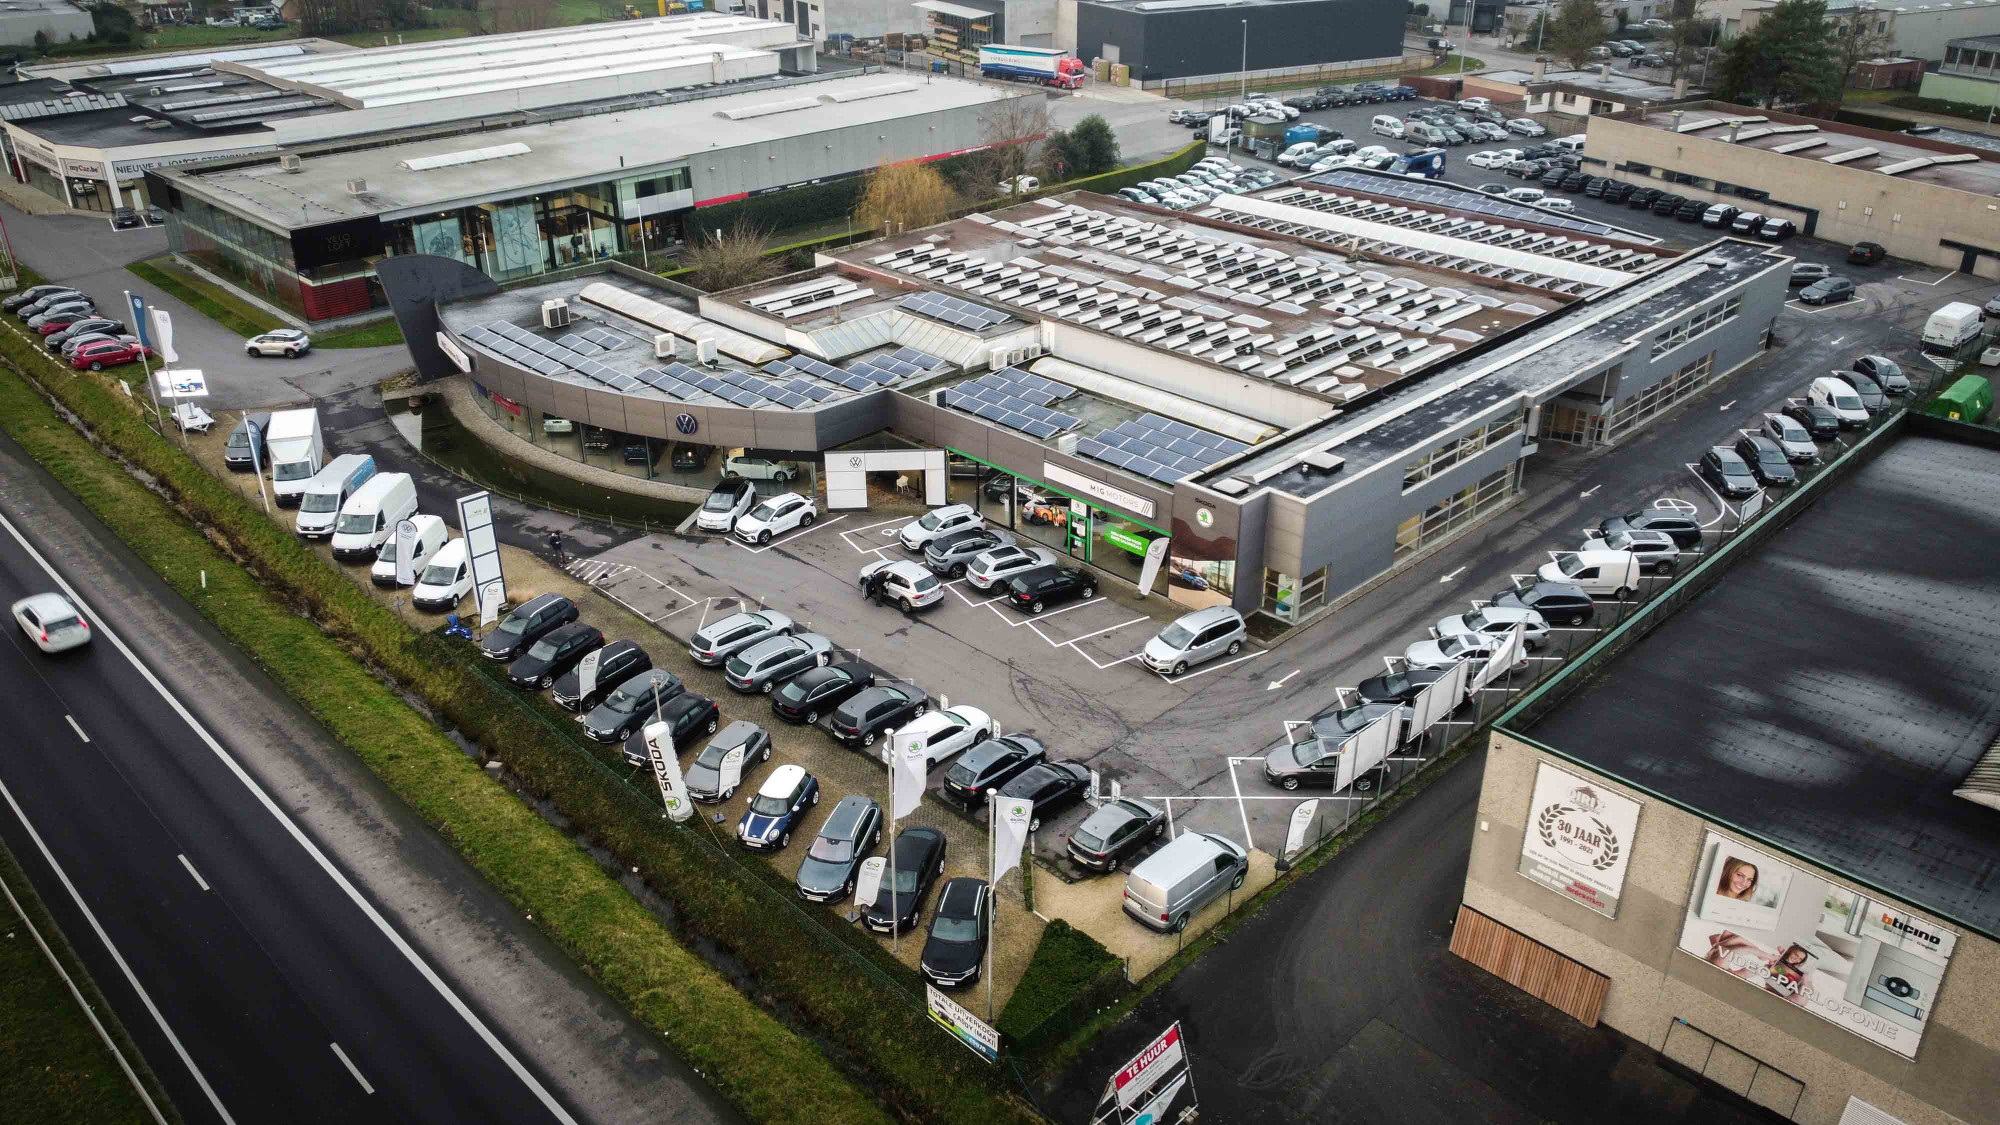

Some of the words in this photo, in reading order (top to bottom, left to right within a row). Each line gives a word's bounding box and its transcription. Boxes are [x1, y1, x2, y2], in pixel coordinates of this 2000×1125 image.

[69, 165, 98, 173] myCar.be
[1090, 484, 1105, 495] MIG
[1106, 491, 1139, 508] MOTORS
[1557, 819, 1572, 834] 30
[1574, 826, 1602, 848] JAAR
[1560, 835, 1574, 846] 1991
[1578, 844, 1594, 855] 2021
[1881, 913, 1941, 945] bticino
[929, 988, 954, 1009] TOTALE
[1718, 945, 1899, 1040] VIDEO-PARLOFONIE
[1126, 1063, 1139, 1079] TE
[1139, 1039, 1168, 1069] HUUR
